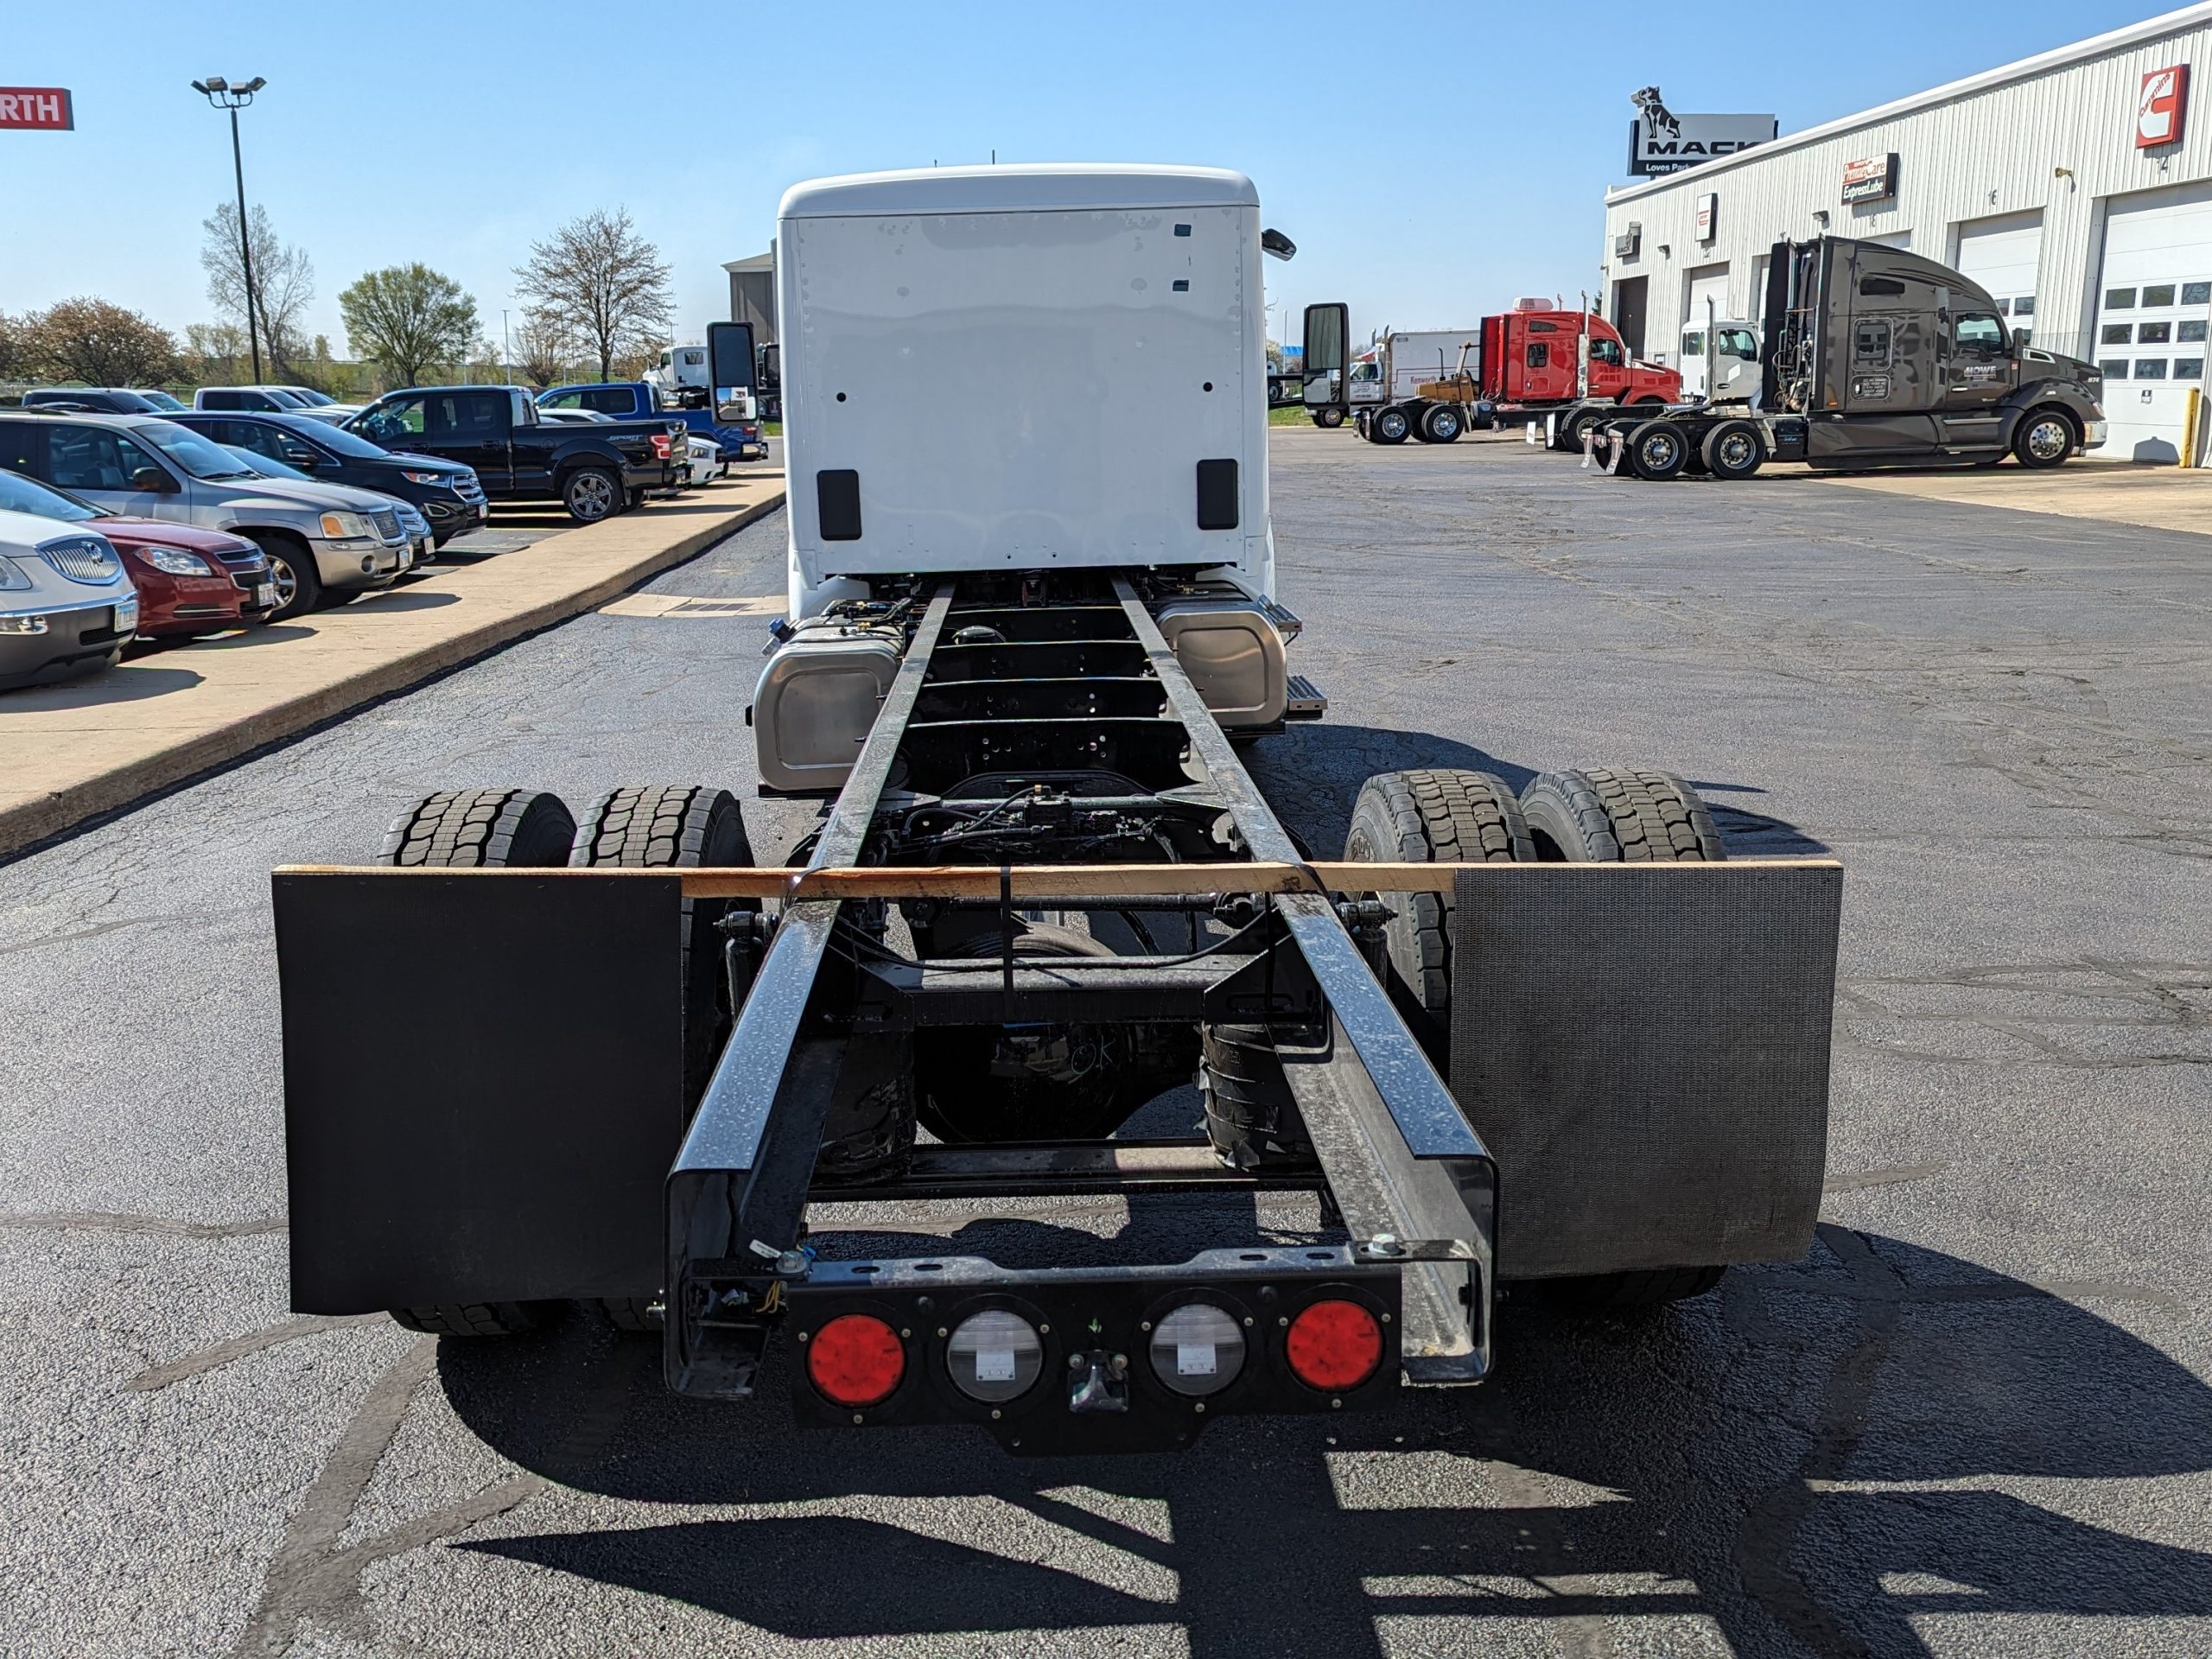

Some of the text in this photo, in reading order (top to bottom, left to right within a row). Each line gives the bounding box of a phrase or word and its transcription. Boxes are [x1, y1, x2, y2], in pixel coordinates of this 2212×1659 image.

[1645, 162, 1670, 172] Loves
[1843, 179, 1884, 201] ExpressLube
[1966, 365, 1997, 374] HOWE
[1071, 1034, 1116, 1075] OK
